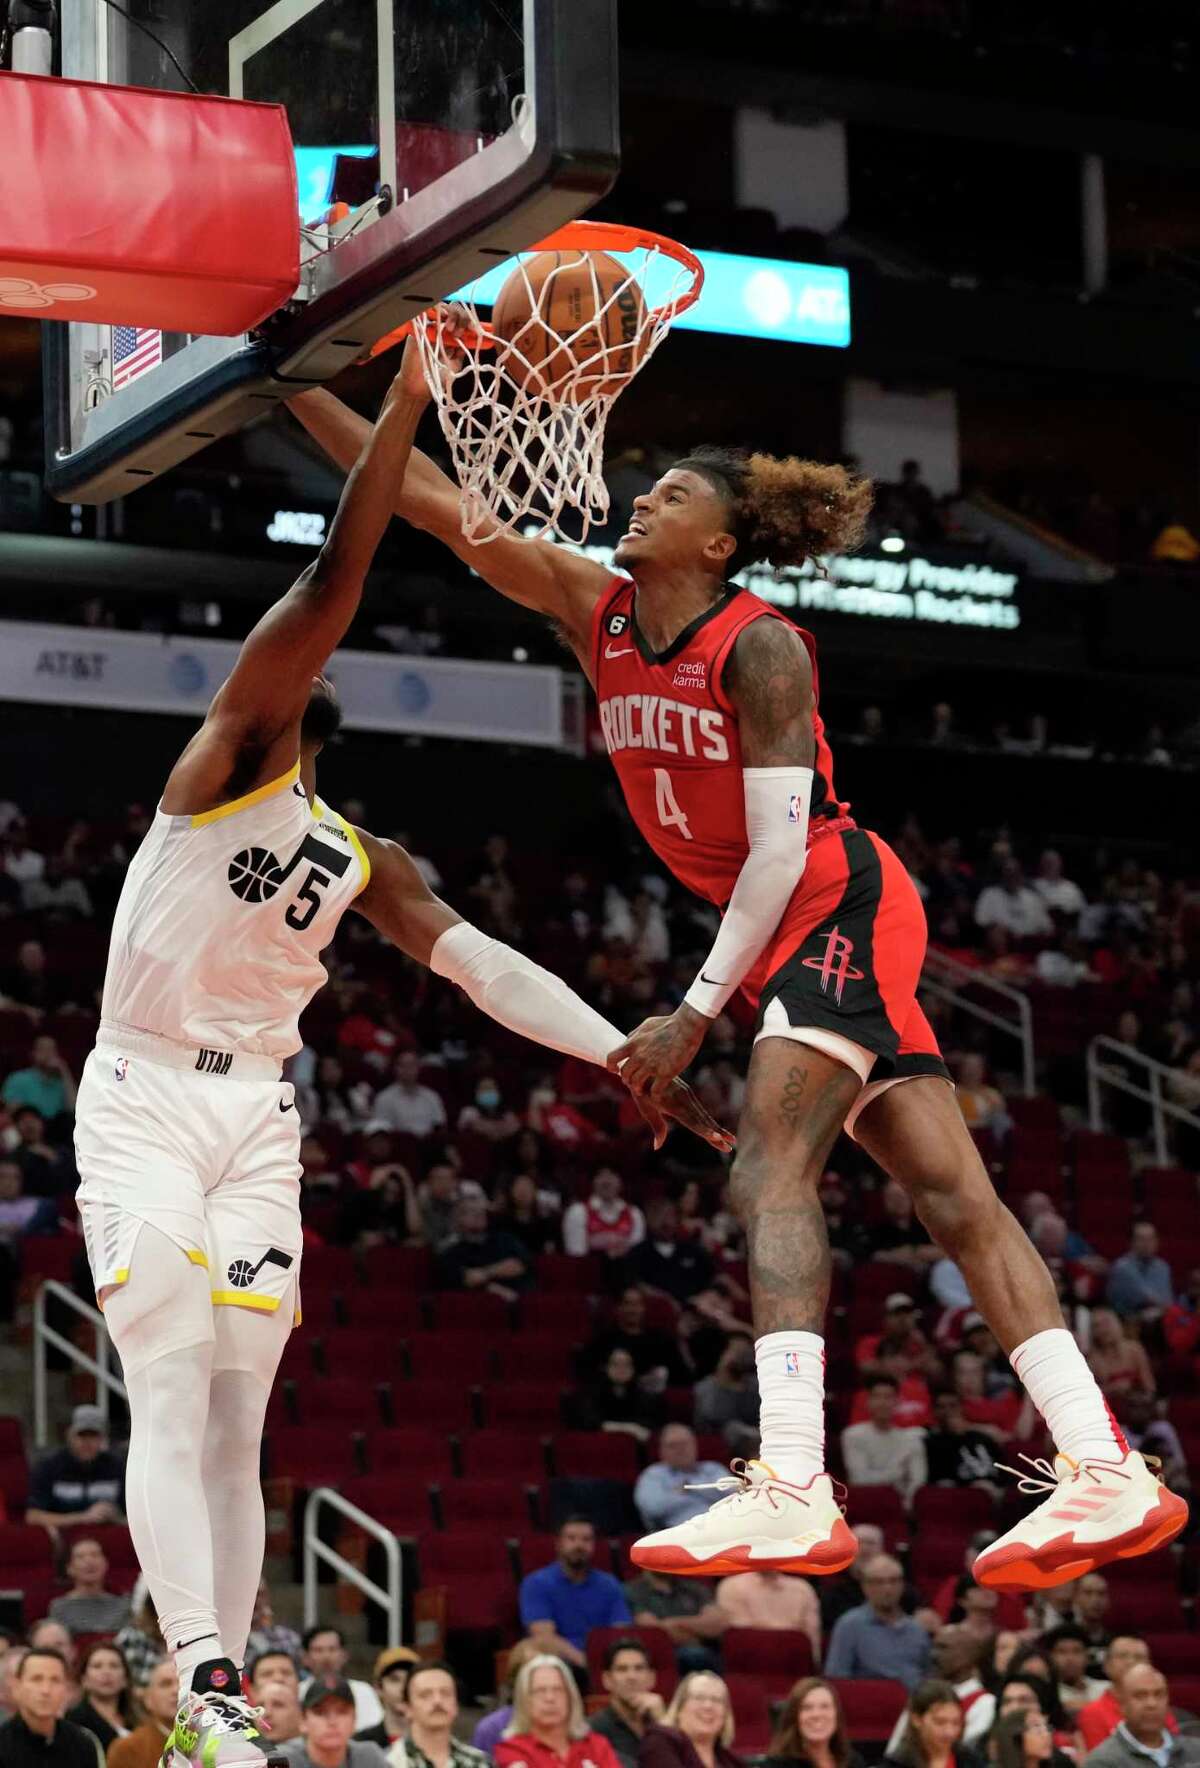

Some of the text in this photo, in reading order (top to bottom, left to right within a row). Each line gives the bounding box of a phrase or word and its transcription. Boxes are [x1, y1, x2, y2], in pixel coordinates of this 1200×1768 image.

[608, 615, 626, 635] 6
[34, 651, 108, 681] AT&T
[677, 661, 705, 676] credit
[672, 673, 706, 690] karma
[599, 693, 729, 762] ROCKETS
[654, 767, 693, 840] 4
[285, 867, 331, 931] 5
[194, 1048, 234, 1075] UTAH
